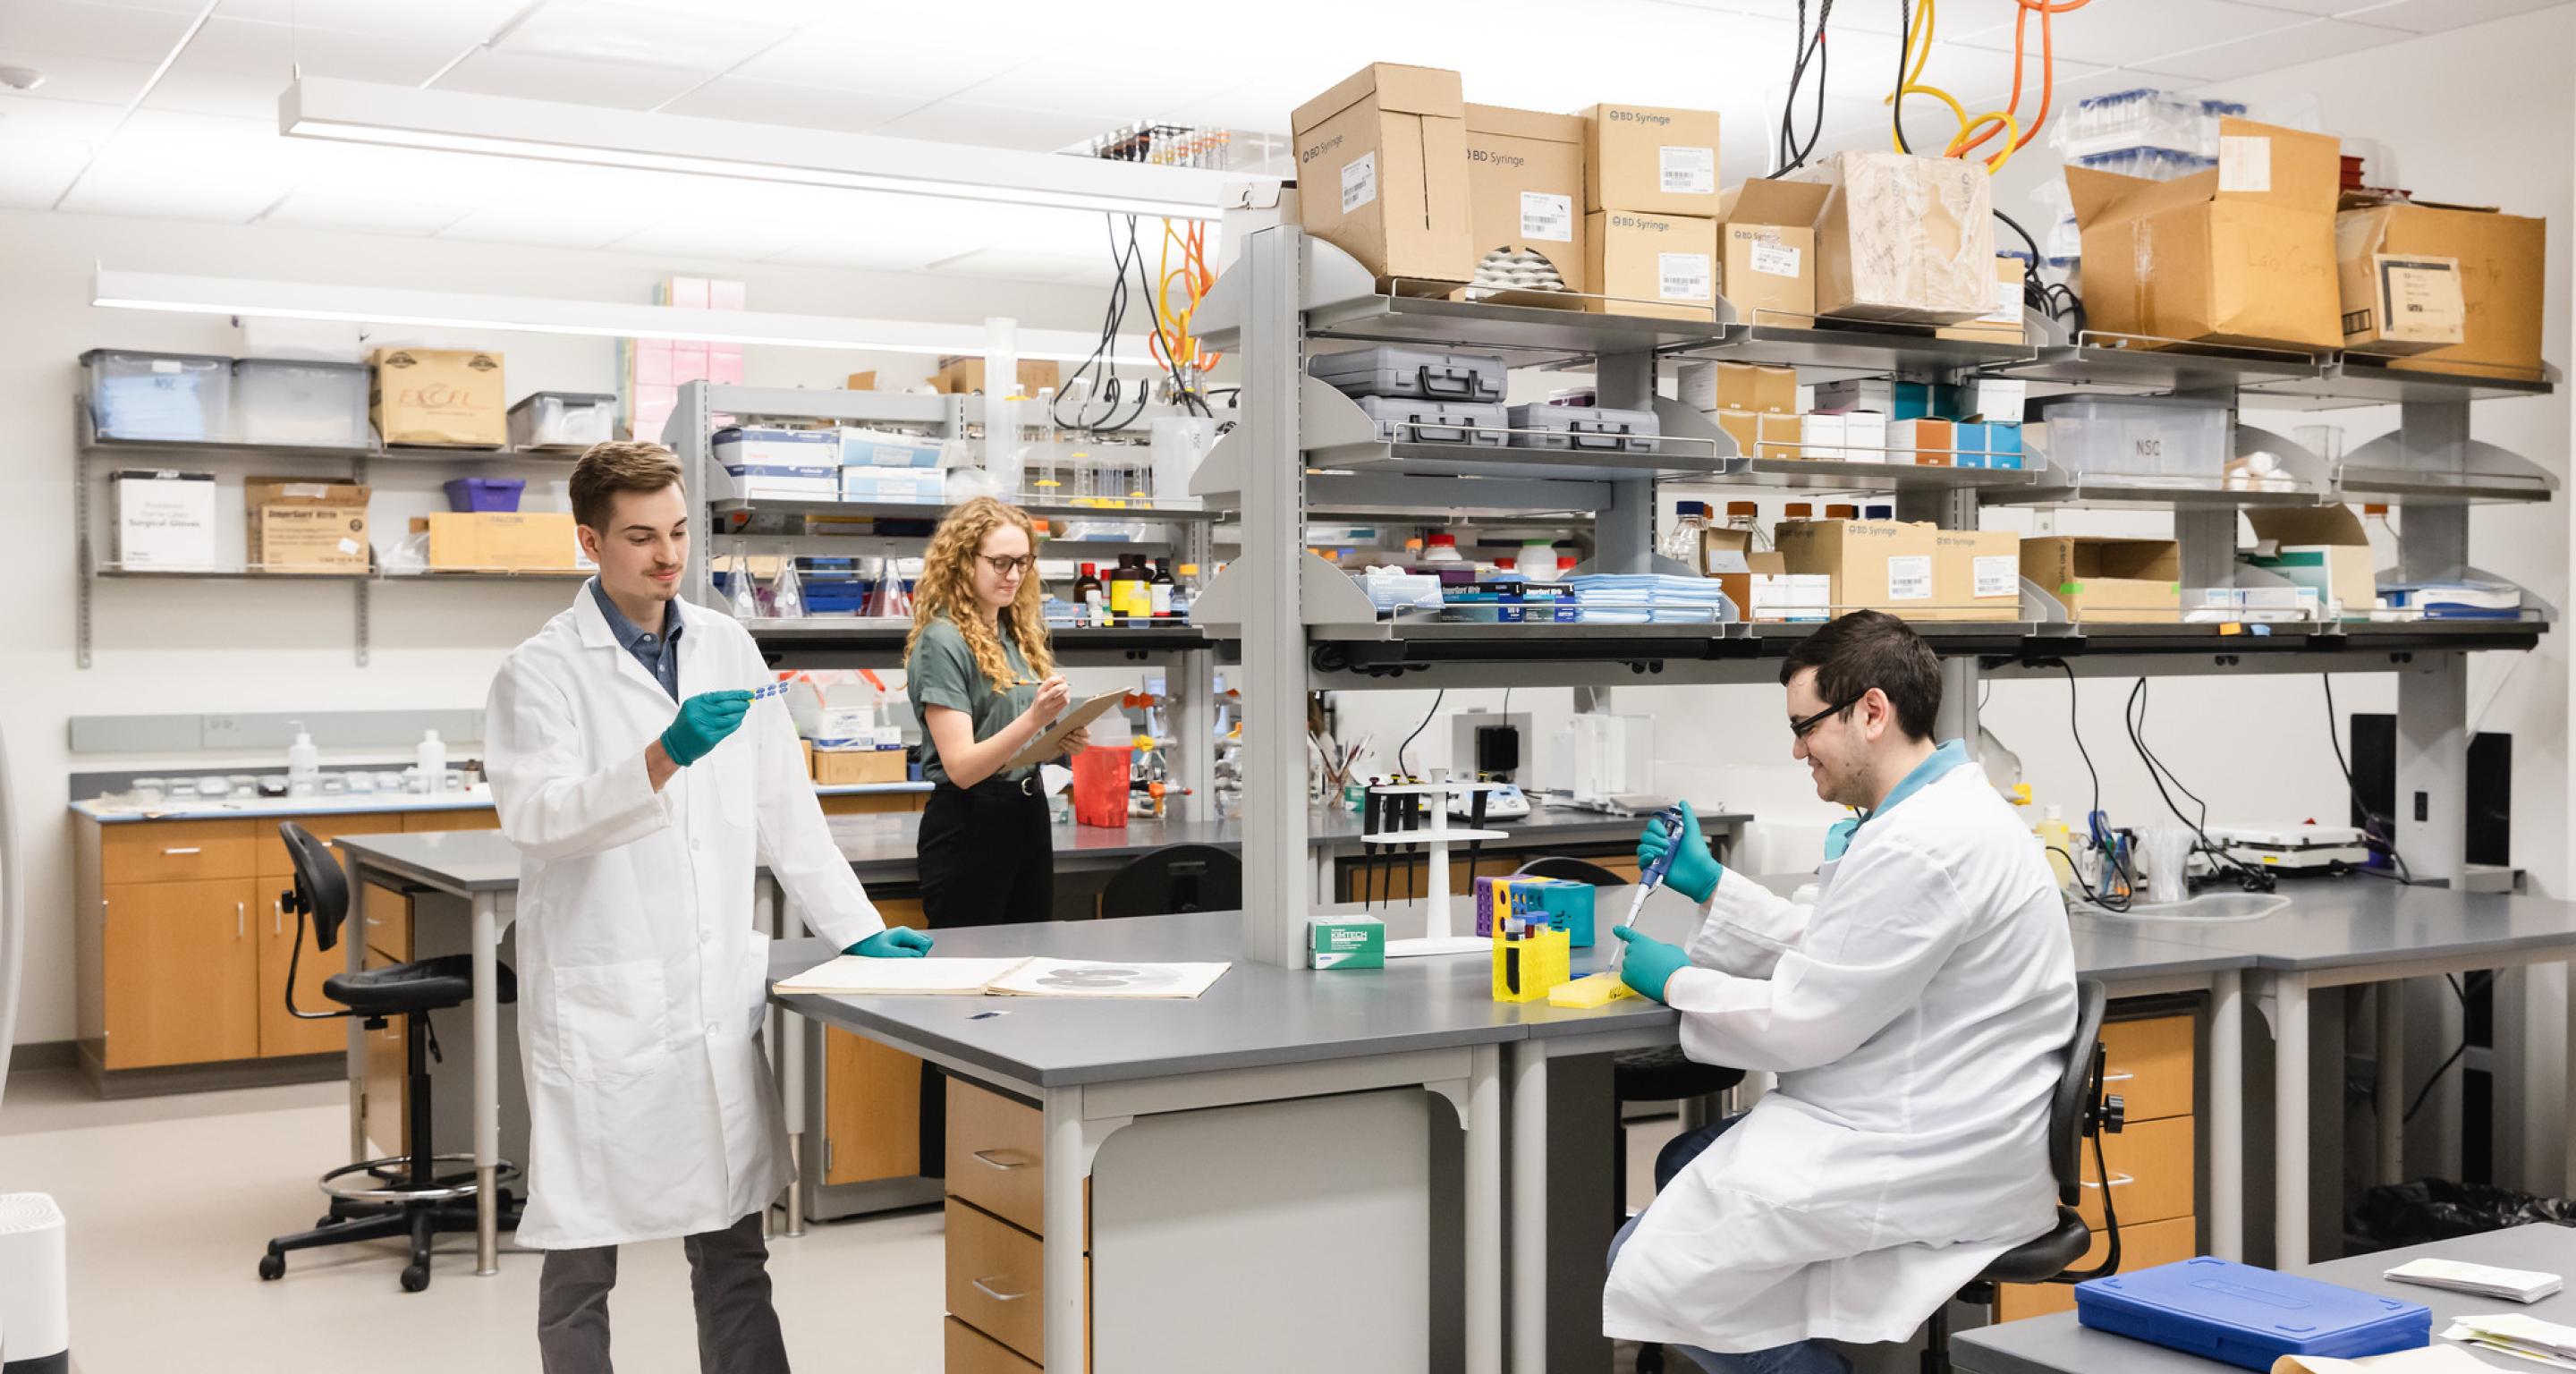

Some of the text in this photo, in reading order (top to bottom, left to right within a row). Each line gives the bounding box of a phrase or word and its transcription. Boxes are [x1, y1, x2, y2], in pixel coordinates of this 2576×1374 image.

[1620, 112, 1671, 125] BD Syringe
[1309, 135, 1343, 159] BD Syringe
[1473, 150, 1524, 167] BD Syringe
[1622, 218, 1669, 232] BD Syringe
[1742, 231, 1752, 239] BD
[2135, 439, 2160, 456] NSC
[1857, 526, 1896, 536] BD Syringe
